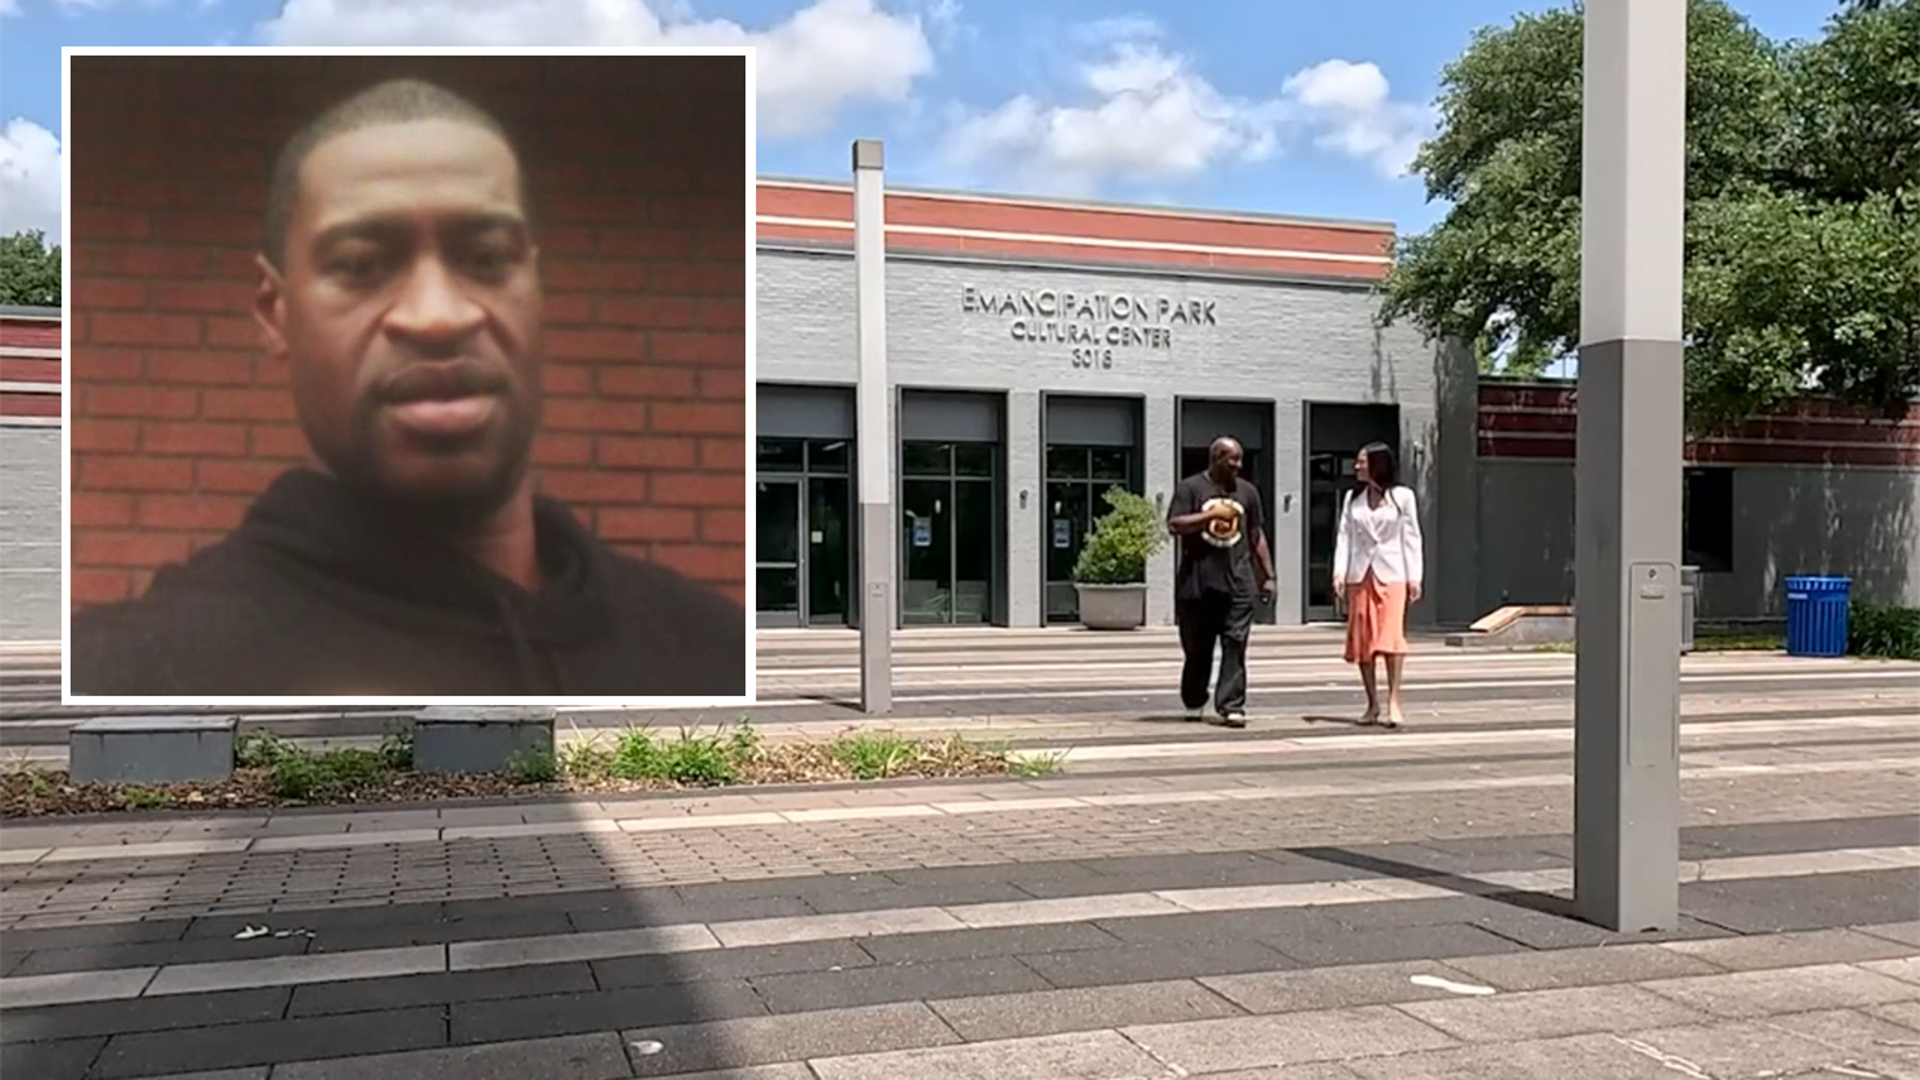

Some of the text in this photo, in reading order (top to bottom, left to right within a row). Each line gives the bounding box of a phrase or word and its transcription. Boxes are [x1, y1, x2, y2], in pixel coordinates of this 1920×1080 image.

[962, 287, 1217, 326] EMANCIPATION PARK
[1010, 321, 1171, 349] CULTURAL CENTER
